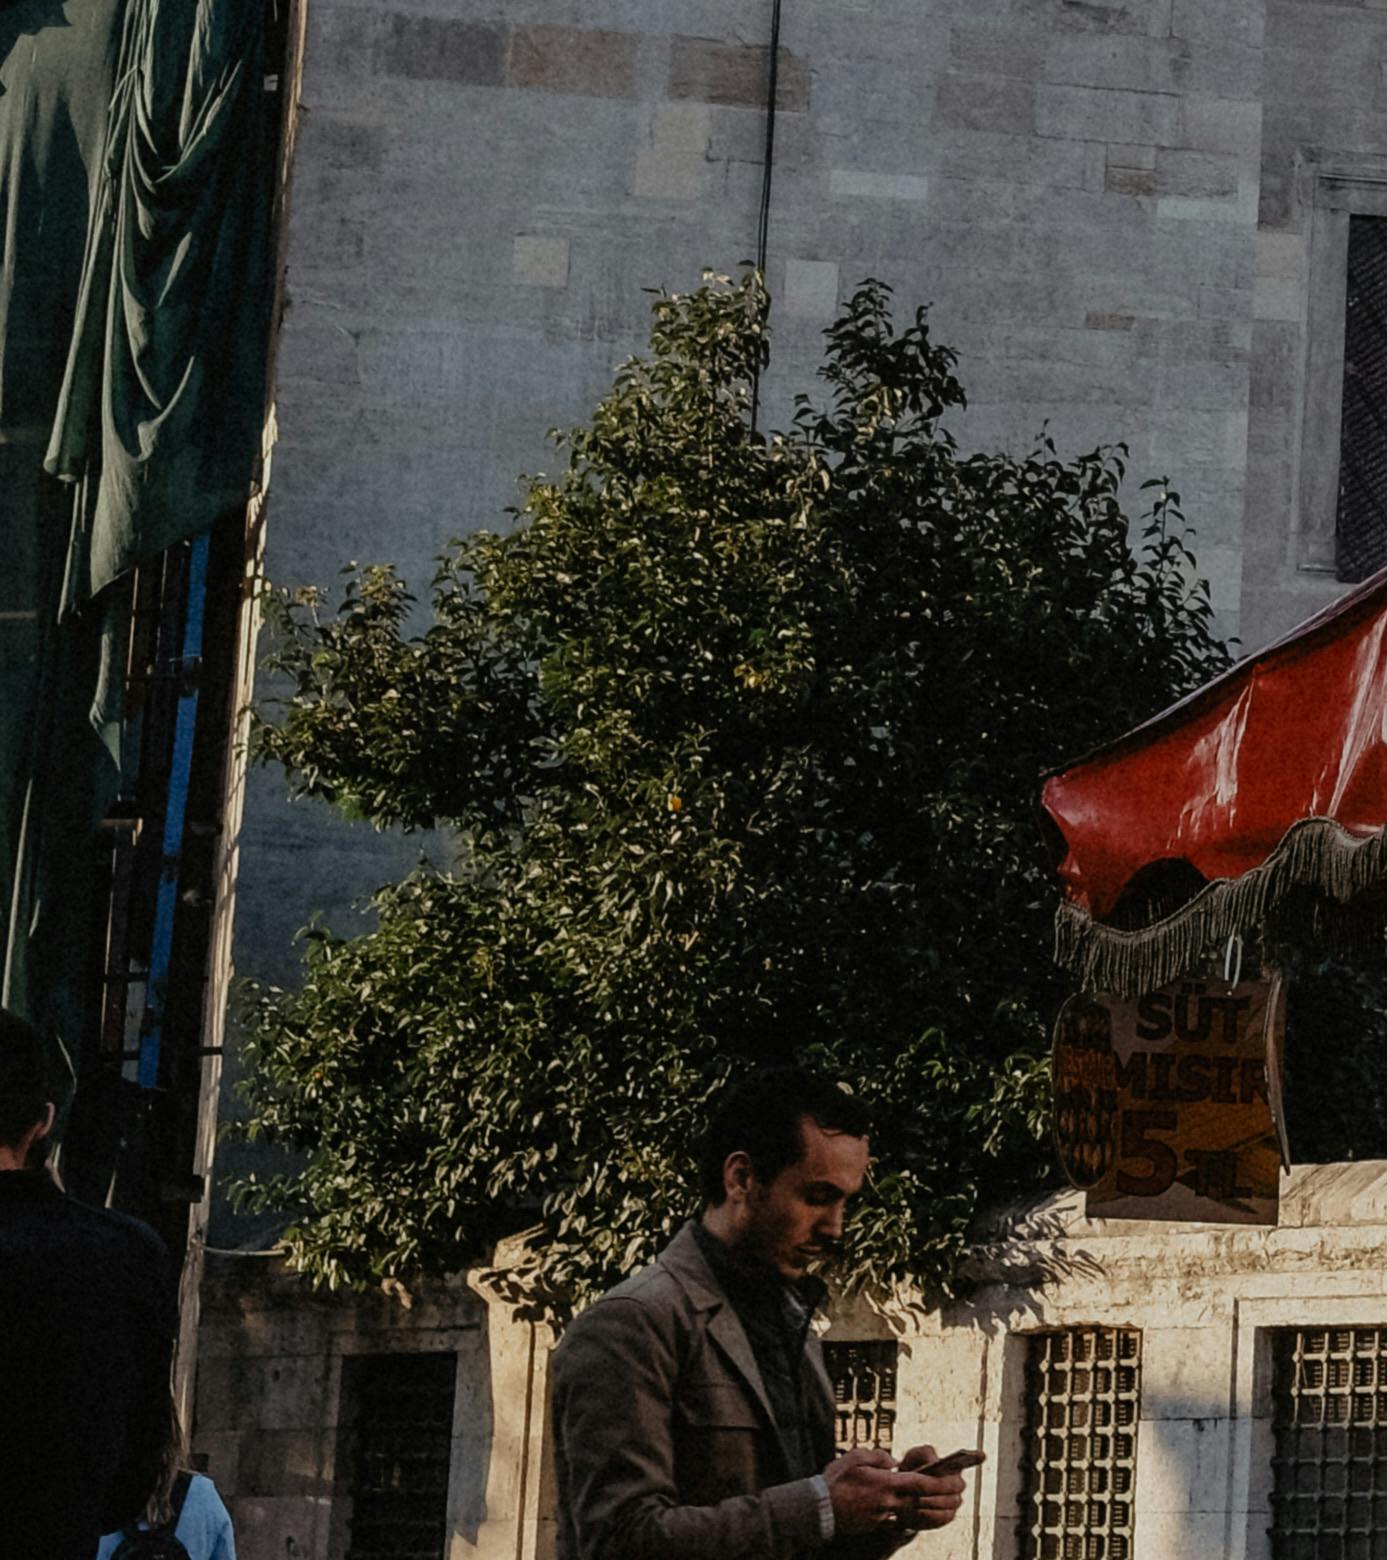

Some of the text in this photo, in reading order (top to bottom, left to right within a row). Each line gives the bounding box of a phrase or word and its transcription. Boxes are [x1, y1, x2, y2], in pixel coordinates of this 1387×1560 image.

[1136, 983, 1251, 1044] SÜT
[1114, 1051, 1268, 1105] MISIR
[1116, 1109, 1253, 1199] 5 TL
